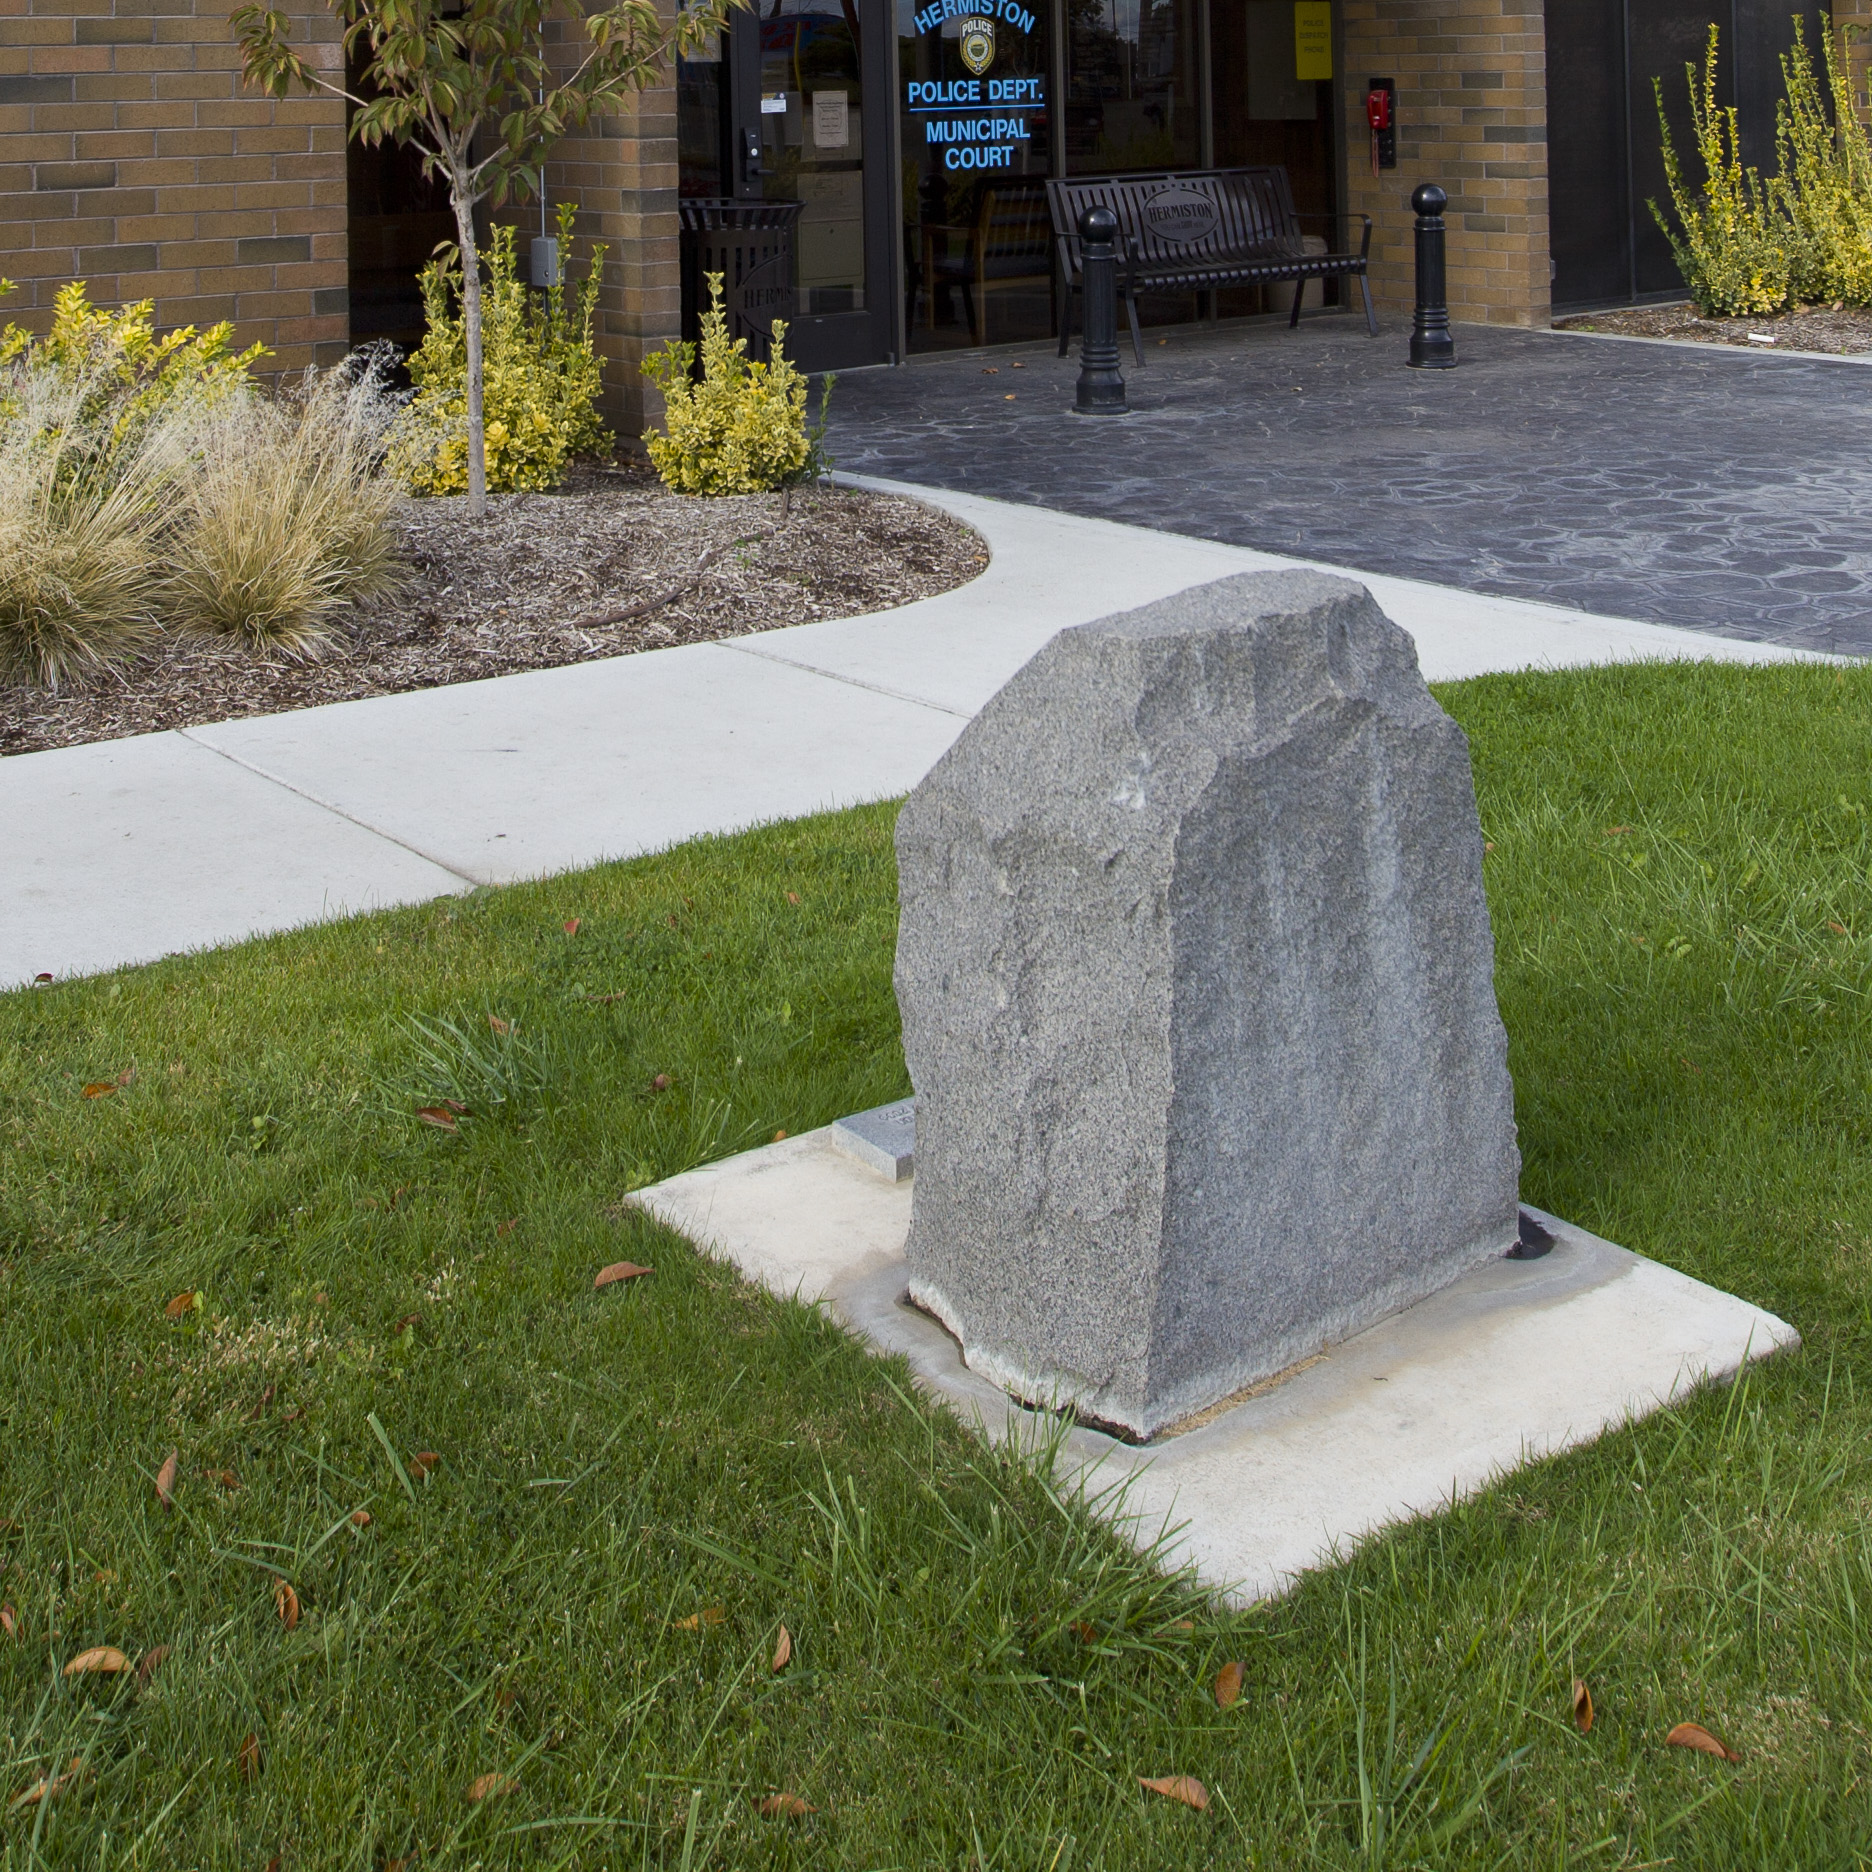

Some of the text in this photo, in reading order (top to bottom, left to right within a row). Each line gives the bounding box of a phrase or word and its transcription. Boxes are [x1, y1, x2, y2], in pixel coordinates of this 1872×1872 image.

[962, 19, 993, 37] POLICE
[908, 78, 1044, 104] POLICE DEPT.
[926, 118, 1031, 143] MUNICIPAL
[945, 146, 1014, 170] COURT
[1148, 202, 1214, 224] HERMISTON
